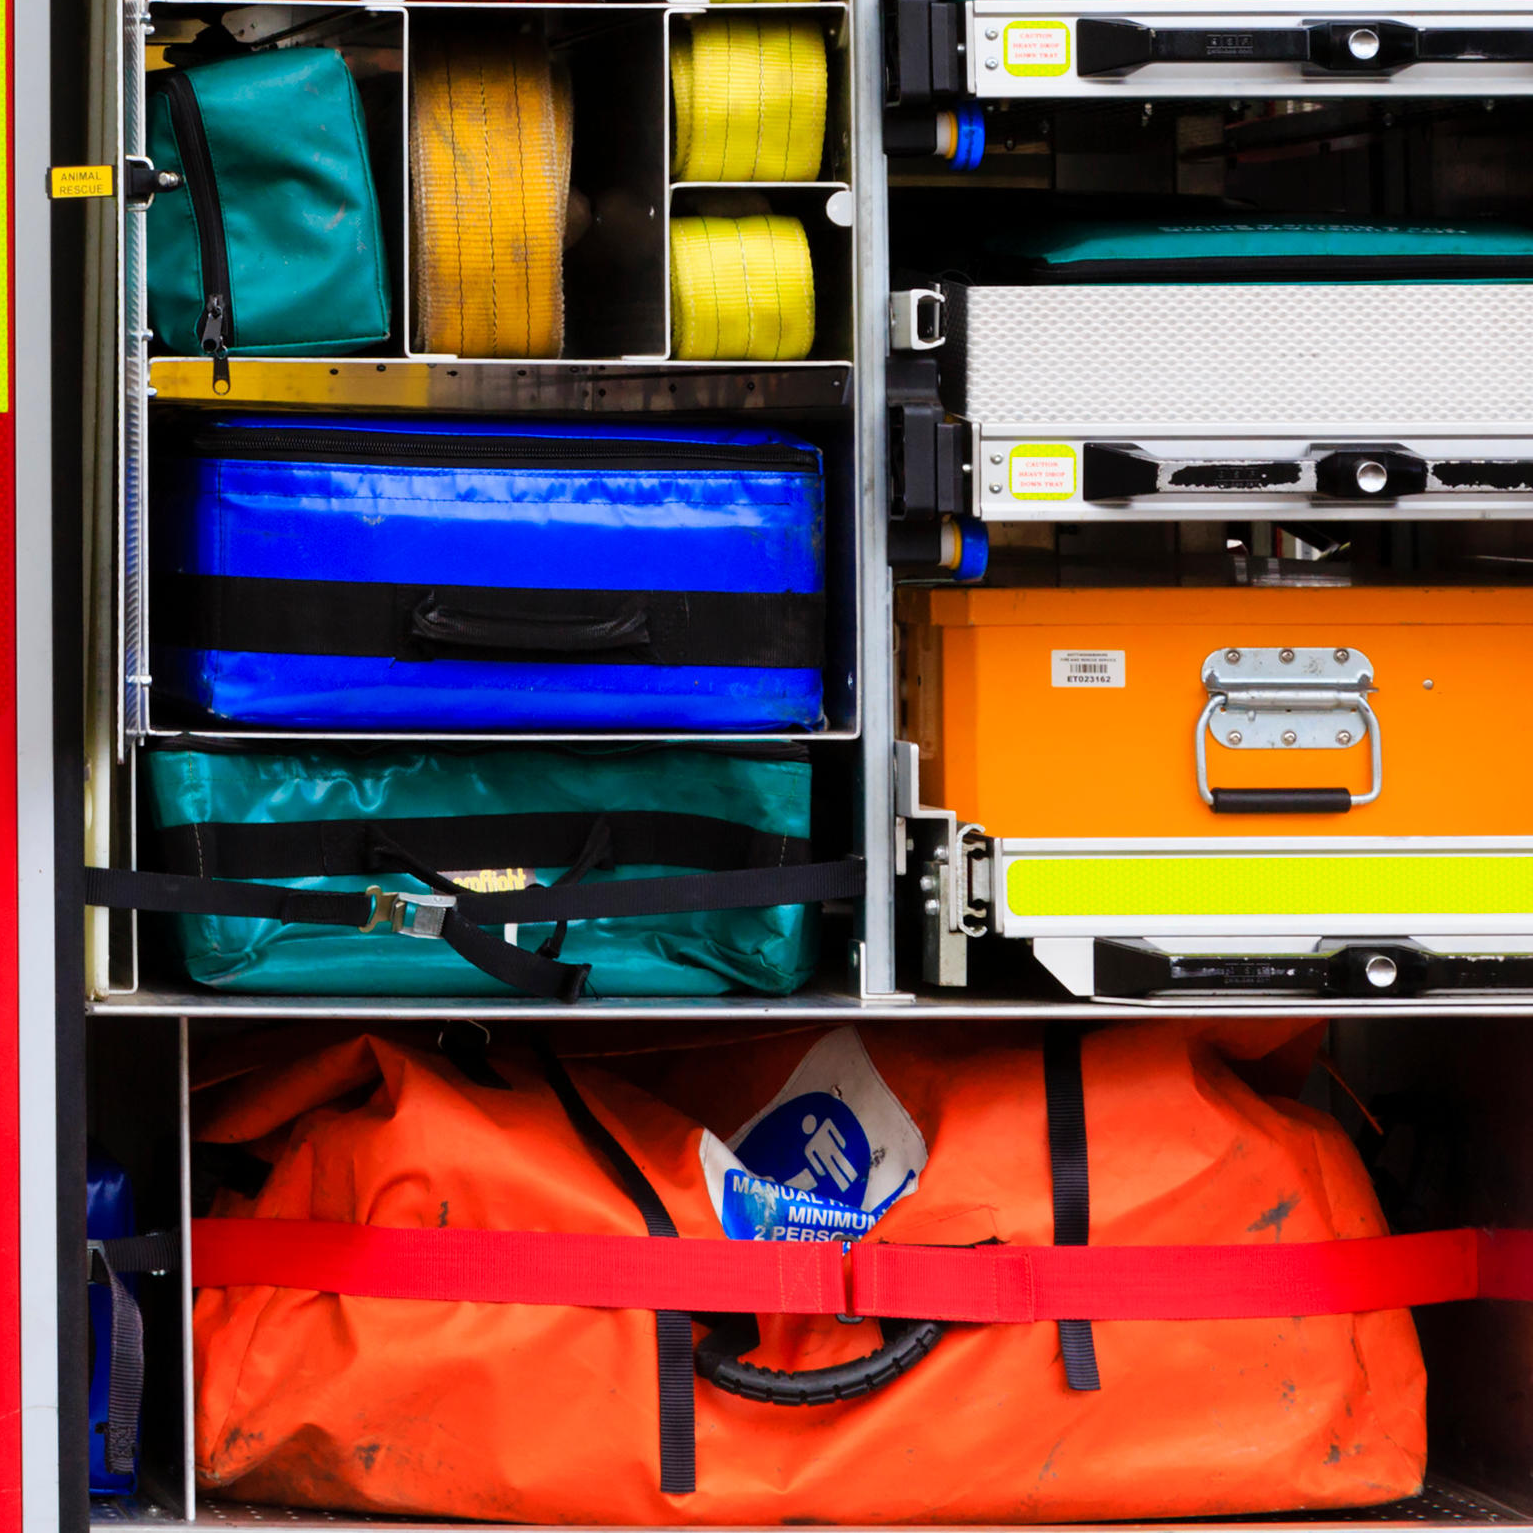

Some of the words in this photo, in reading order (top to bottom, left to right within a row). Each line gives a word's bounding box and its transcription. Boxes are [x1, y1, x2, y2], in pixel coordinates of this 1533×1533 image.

[60, 170, 102, 182] ANIMAL
[59, 184, 105, 196] RESCUE
[1066, 675, 1112, 683] ET023162
[733, 1174, 824, 1206] MANUAL
[753, 1224, 767, 1241] 2
[772, 1225, 862, 1242] PERS
